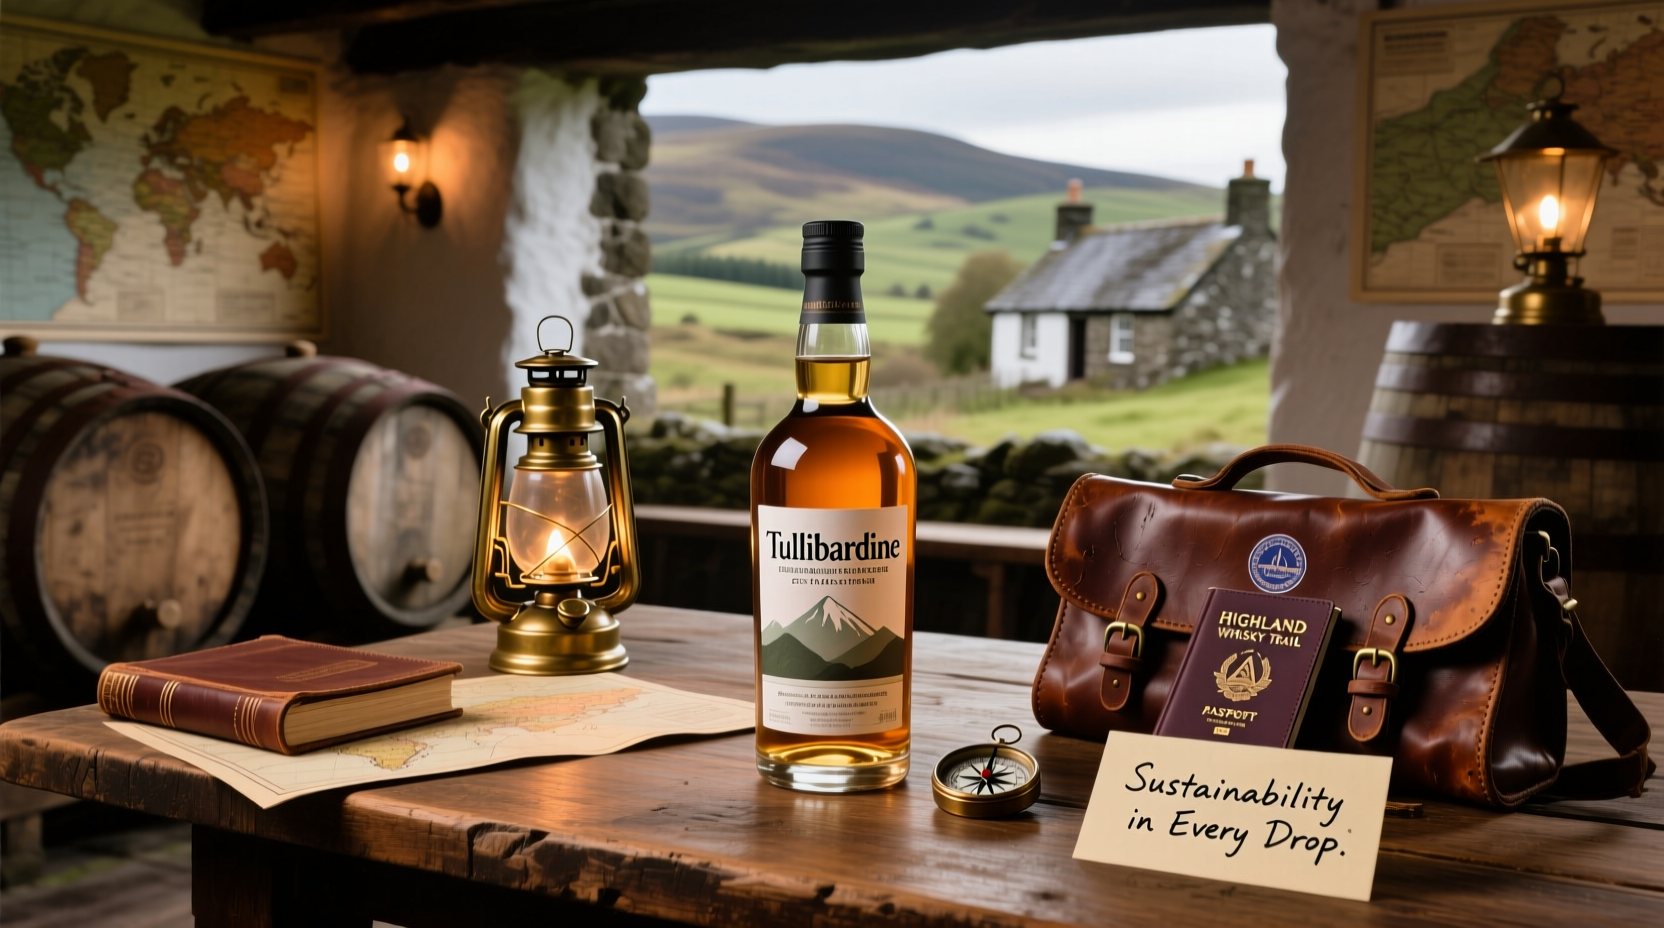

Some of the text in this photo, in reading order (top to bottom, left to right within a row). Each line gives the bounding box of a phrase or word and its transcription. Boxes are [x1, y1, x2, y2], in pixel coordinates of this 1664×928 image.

[766, 530, 900, 561] Tullibardine
[1218, 627, 1301, 647] WHISKY TRAIL
[1219, 611, 1307, 633] HIGHLAND
[1125, 762, 1344, 827] Sustainability
[1128, 809, 1346, 866] in Every Drop.
